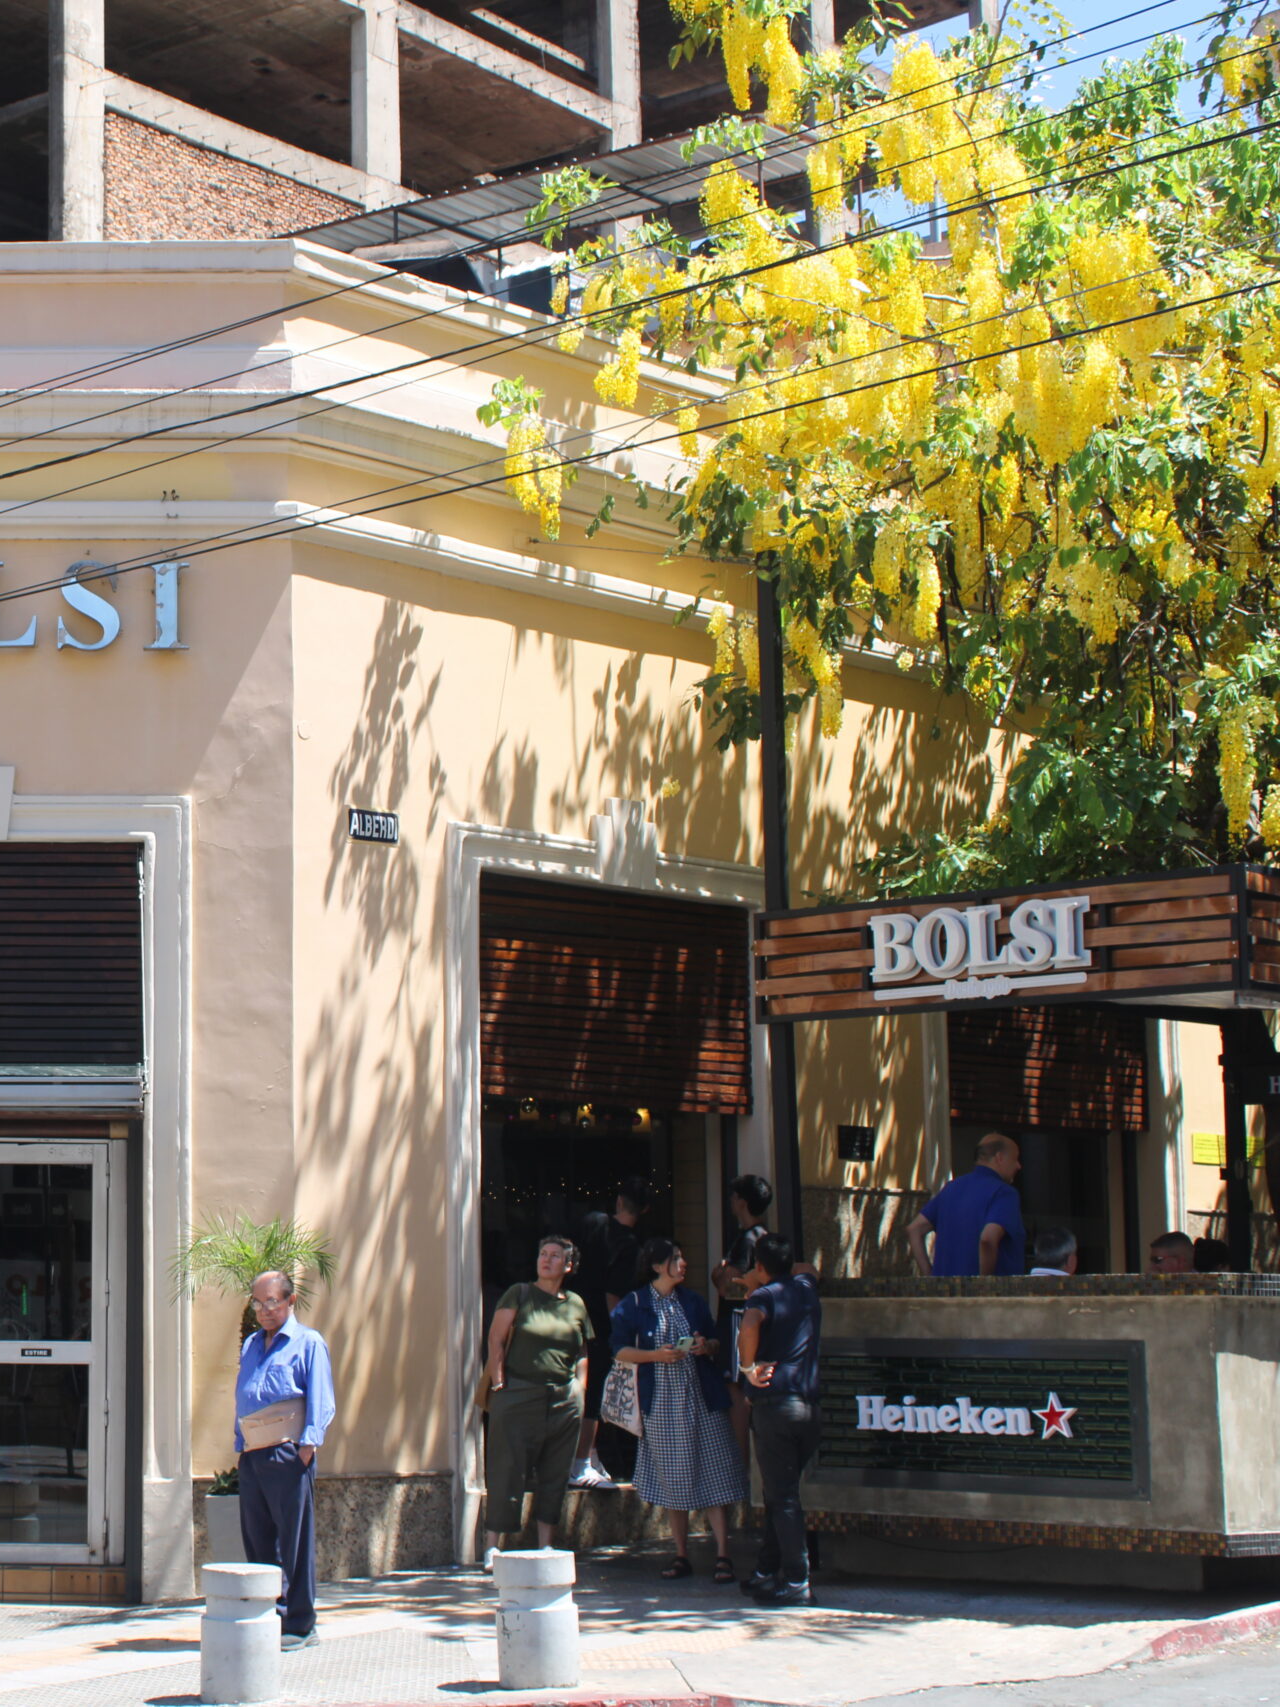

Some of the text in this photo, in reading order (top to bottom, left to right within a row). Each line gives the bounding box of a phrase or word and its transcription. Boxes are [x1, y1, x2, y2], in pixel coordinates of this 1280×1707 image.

[349, 812, 398, 841] ALBERDI
[867, 895, 1092, 983] BOLSI
[856, 1395, 1034, 1436] Heineken
